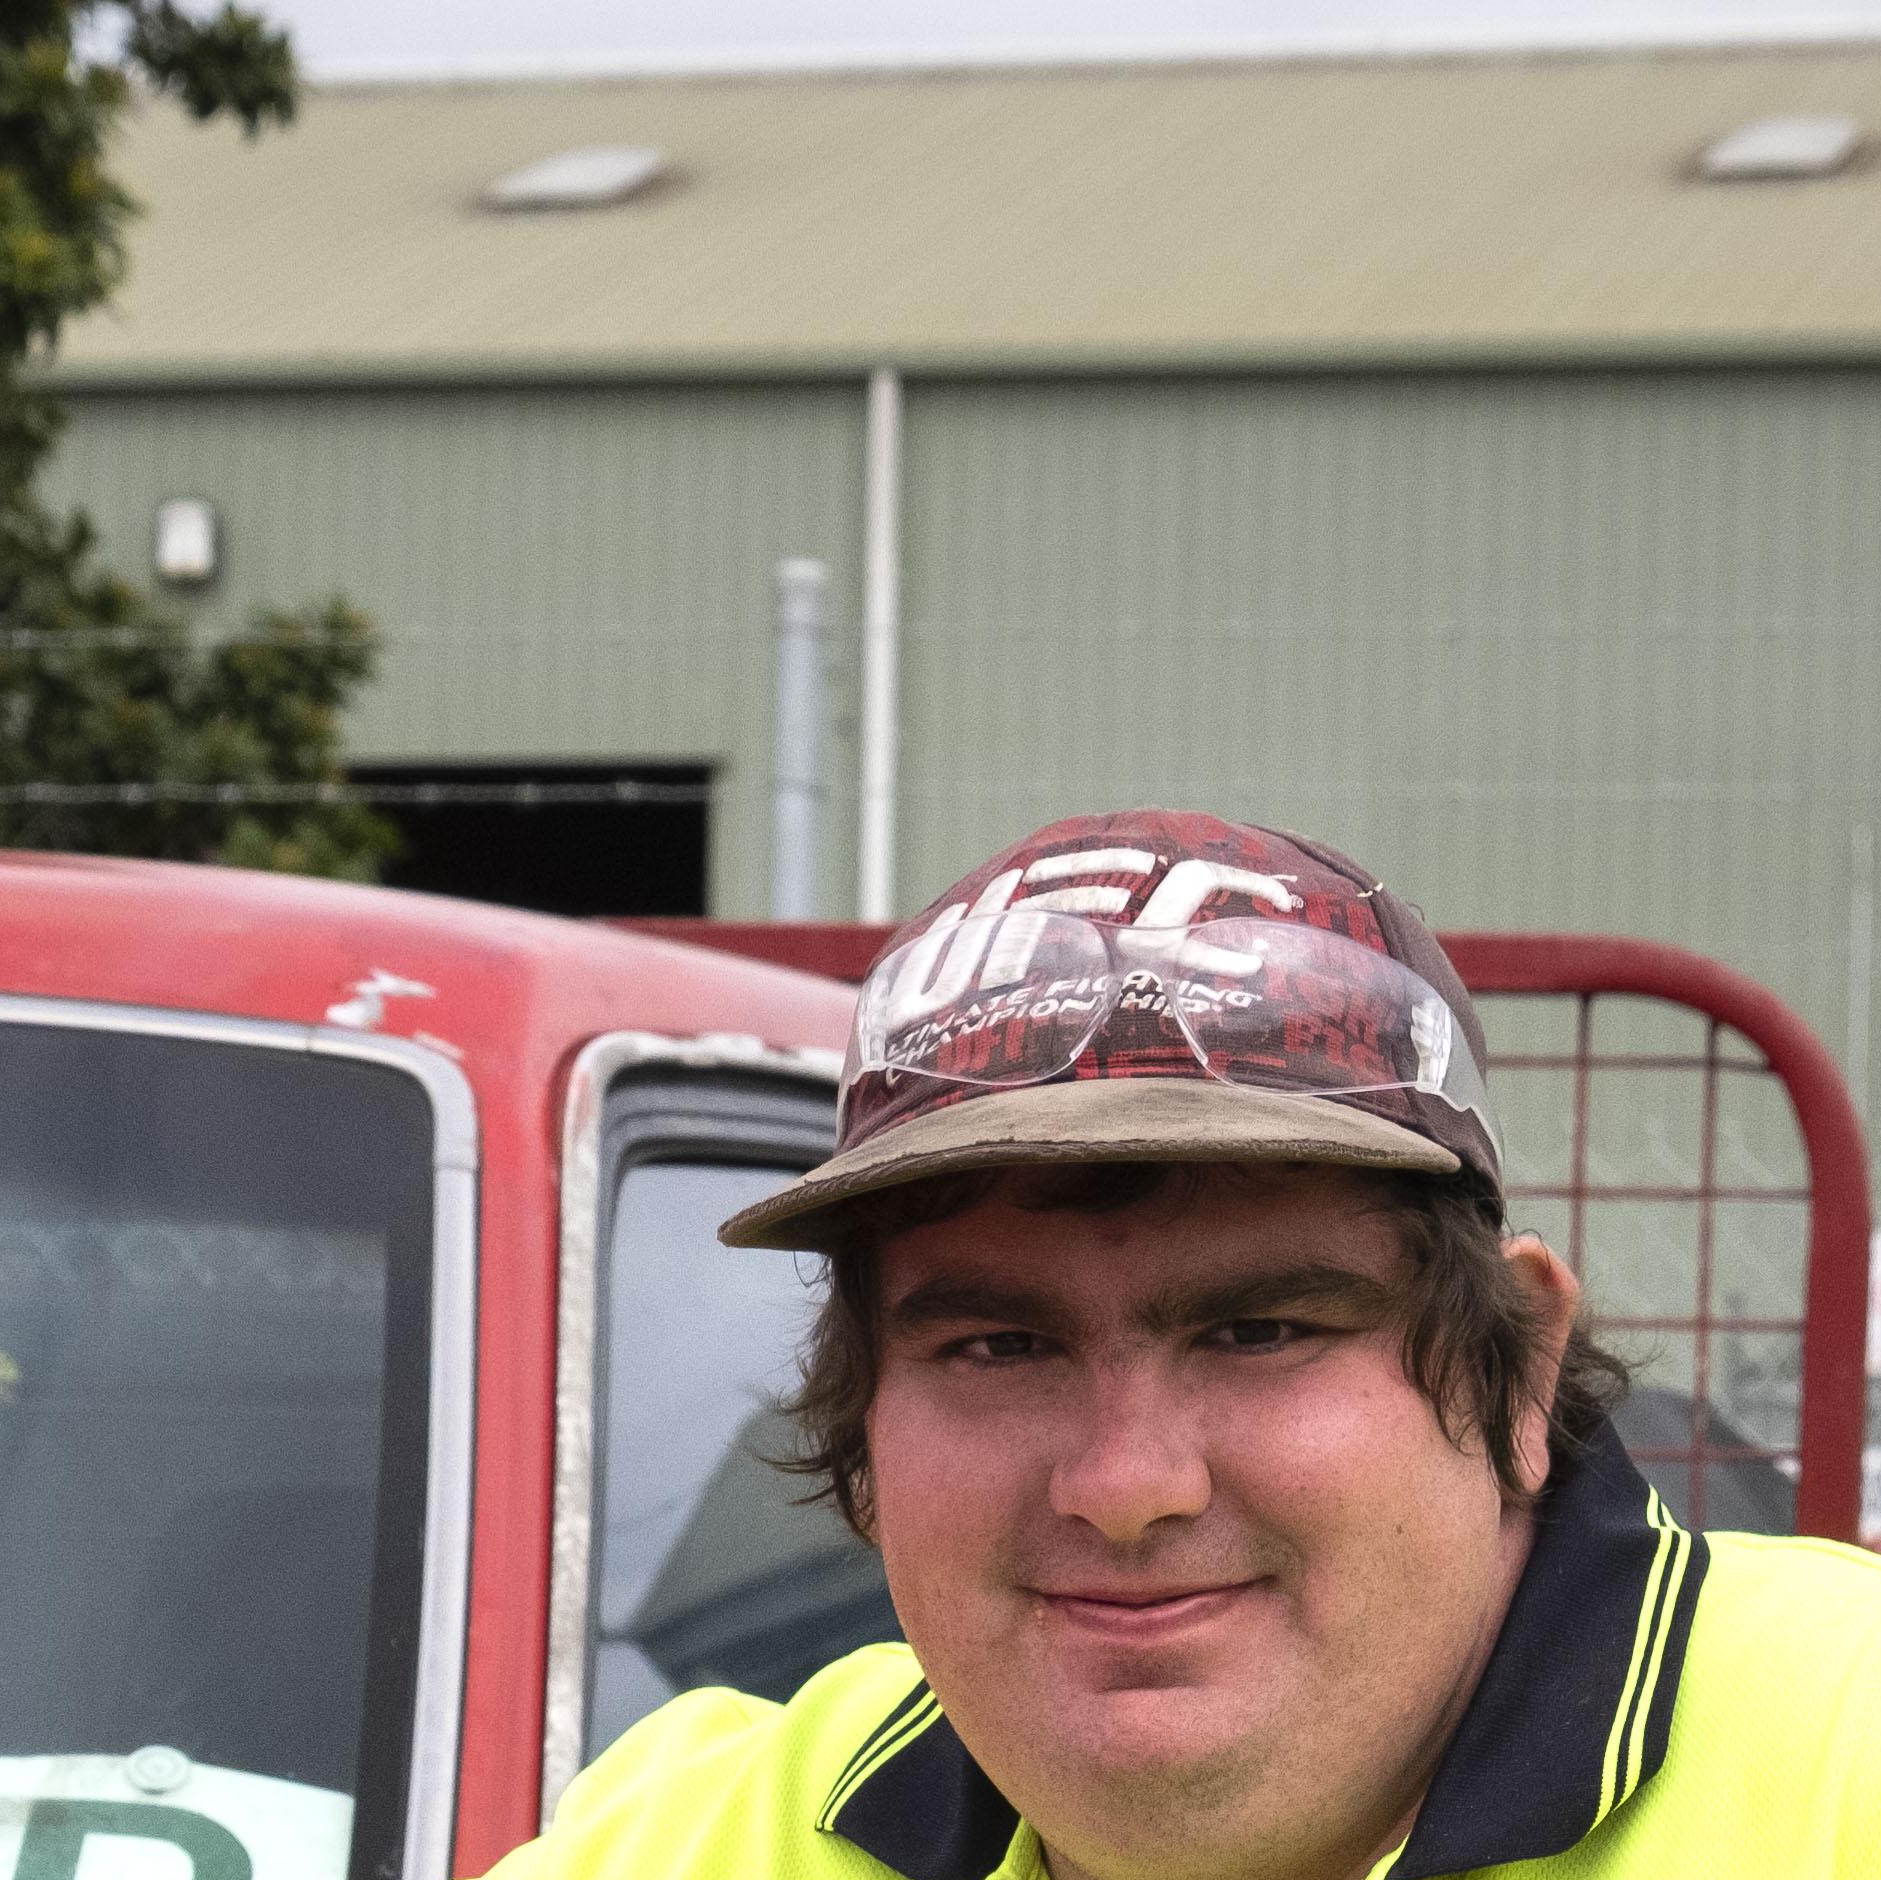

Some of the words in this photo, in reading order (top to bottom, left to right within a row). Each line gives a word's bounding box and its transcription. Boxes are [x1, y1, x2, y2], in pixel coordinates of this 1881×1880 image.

[883, 847, 1293, 1030] UFC
[882, 986, 1035, 1060] LTIMATE
[885, 990, 1212, 1088] CHAMPIONHIP
